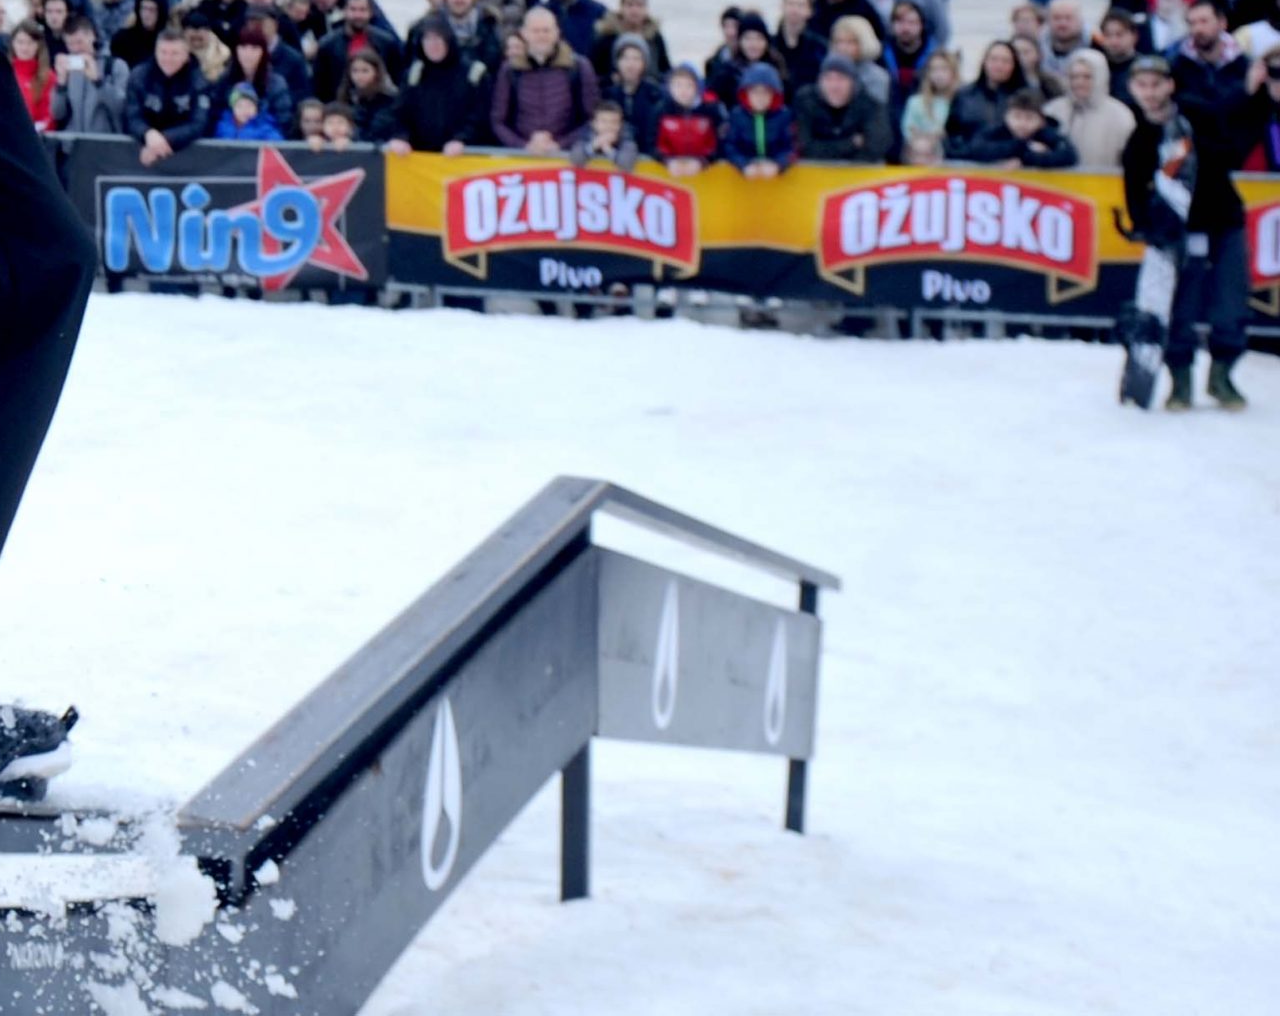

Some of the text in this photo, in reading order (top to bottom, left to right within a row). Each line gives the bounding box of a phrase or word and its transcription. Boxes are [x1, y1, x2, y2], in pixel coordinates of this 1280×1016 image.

[463, 170, 677, 247] Ožujsko
[839, 179, 1074, 263] Ožujsko
[539, 257, 603, 287] Pivo
[922, 269, 991, 303] Pivo
